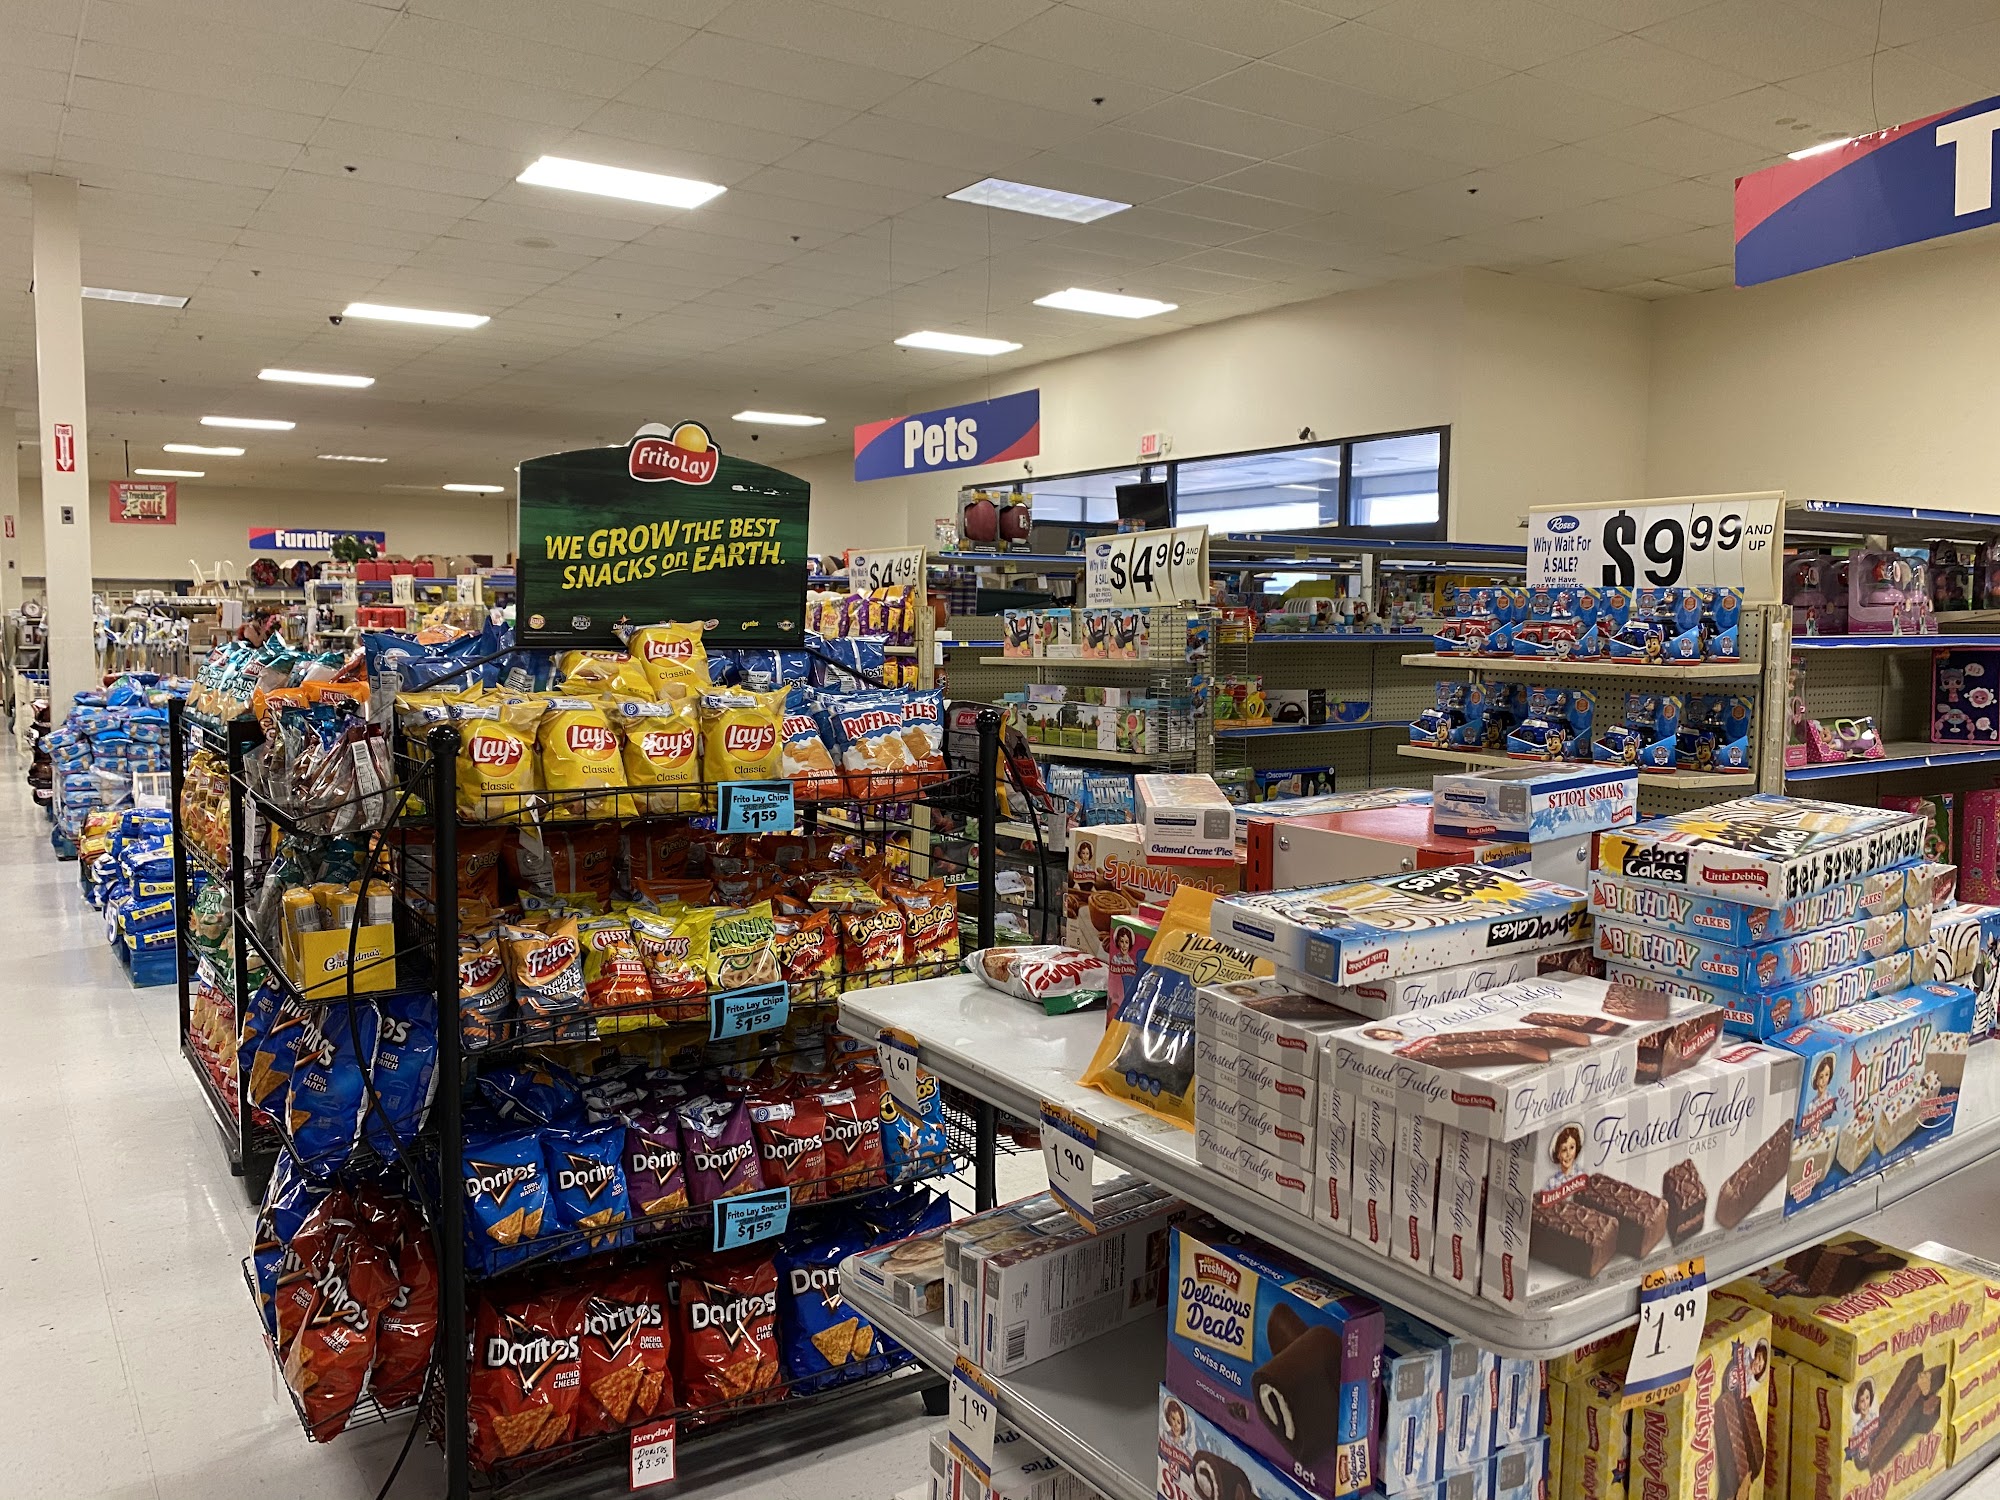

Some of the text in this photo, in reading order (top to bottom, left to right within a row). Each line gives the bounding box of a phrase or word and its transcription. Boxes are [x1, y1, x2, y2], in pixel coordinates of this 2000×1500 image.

[904, 417, 978, 469] Pets
[1141, 435, 1157, 453] EXIT
[139, 500, 163, 515] SALE
[545, 518, 780, 560] WE GROW THE BEST
[1745, 524, 1773, 535] AND
[1186, 547, 1199, 555] AND
[1533, 536, 1591, 556] Why Wait For
[1748, 540, 1766, 551] UP
[562, 541, 786, 590] SNACKS on EARTH.
[1543, 557, 1578, 572] A SALE?
[648, 638, 692, 659] Lay's
[571, 725, 615, 751] Lay's
[727, 720, 774, 751] Lay's
[475, 736, 521, 766] Lay's
[582, 765, 615, 774] Classic
[656, 773, 688, 782] Classic
[734, 765, 766, 774] Classic
[1266, 771, 1293, 779] Discovery
[480, 781, 515, 791] Classic
[1052, 779, 1081, 796] HUNT
[1086, 777, 1129, 791] UNDERCOVER
[1092, 787, 1126, 804] HUNT
[1548, 782, 1624, 808] SWISS ROLLS
[733, 793, 789, 804] Frito Lay Chips
[1151, 843, 1233, 856] Oatmeal Creme Pies
[1485, 848, 1528, 861] Marshmallow
[1621, 840, 1688, 866] Zebra
[942, 873, 966, 883] T-REX
[1397, 865, 1482, 892] Cakes
[1625, 860, 1684, 882] Cakes
[1705, 871, 1765, 883] Little Debbie
[1603, 880, 1731, 930] BIRTHDAY CAKES
[1794, 882, 1864, 931] BIRTHDAY
[851, 911, 901, 944] Cheetos
[906, 904, 953, 937] Cheetos
[1490, 906, 1593, 945] Zebra Cakes
[528, 937, 576, 977] Fritos
[1164, 951, 1199, 970] COUNTRY
[1180, 932, 1260, 973] TILLAMOOK
[1611, 923, 1739, 977] BIRTHDAY CAKES
[462, 956, 503, 986] Fritos
[726, 996, 784, 1015] Frito Lay Chips
[1198, 998, 1275, 1046] Frosted Fudge
[381, 1051, 399, 1063] COOL
[1198, 1040, 1274, 1090] Frosted Fudge
[1853, 1023, 1931, 1110] BIRTHDAY
[309, 1072, 328, 1086] COOL
[1336, 1047, 1449, 1103] Frosted Fudge
[1887, 1073, 1915, 1098] CAKES
[1371, 1085, 1394, 1099] CAKES
[1453, 1091, 1493, 1107] Little Debbie
[1514, 1050, 1629, 1130] Frosted Fudge
[1198, 1084, 1273, 1135] Frosted Fudge
[1593, 1076, 1756, 1167] Frosted Fudge
[823, 1115, 879, 1142] Doritos
[695, 1138, 752, 1171] Doritos
[764, 1133, 823, 1160] Doritos
[1199, 1128, 1274, 1181] Frosted Fudge
[1688, 1138, 1718, 1155] CAKES
[465, 1162, 537, 1198] Doritos
[1804, 1156, 1814, 1178] 8
[1542, 1178, 1587, 1204] Little Debbie
[727, 1200, 787, 1219] Frito Lay Snacks
[1198, 1258, 1238, 1286] Freshley's
[1644, 1272, 1685, 1289] Cookies
[1181, 1277, 1251, 1319] Delicious
[1813, 1265, 1950, 1324] Nutty Buddy
[692, 1292, 776, 1330] Doritos
[1186, 1303, 1245, 1347] Deals
[1890, 1300, 1973, 1357] Nutty Buddy
[488, 1334, 580, 1367] Doritos
[640, 1341, 664, 1350] CHEESE
[555, 1370, 580, 1380] NACHO
[956, 1355, 973, 1379] Cake
[1193, 1346, 1242, 1387] Swiss Rolls
[1371, 1354, 1381, 1379] 8ct
[553, 1378, 580, 1389] CHEESE
[1195, 1380, 1226, 1405] CHOCOLATE
[1645, 1383, 1681, 1403] 519700
[1349, 1386, 1359, 1439] Swiss Rolls
[1690, 1354, 1715, 1458] Nutty
[633, 1424, 673, 1444] Everyday!
[1639, 1408, 1669, 1482] Nutty
[1357, 1444, 1366, 1482] Deals
[1892, 1431, 1943, 1486] Buddy
[1294, 1462, 1316, 1487] 8ct
